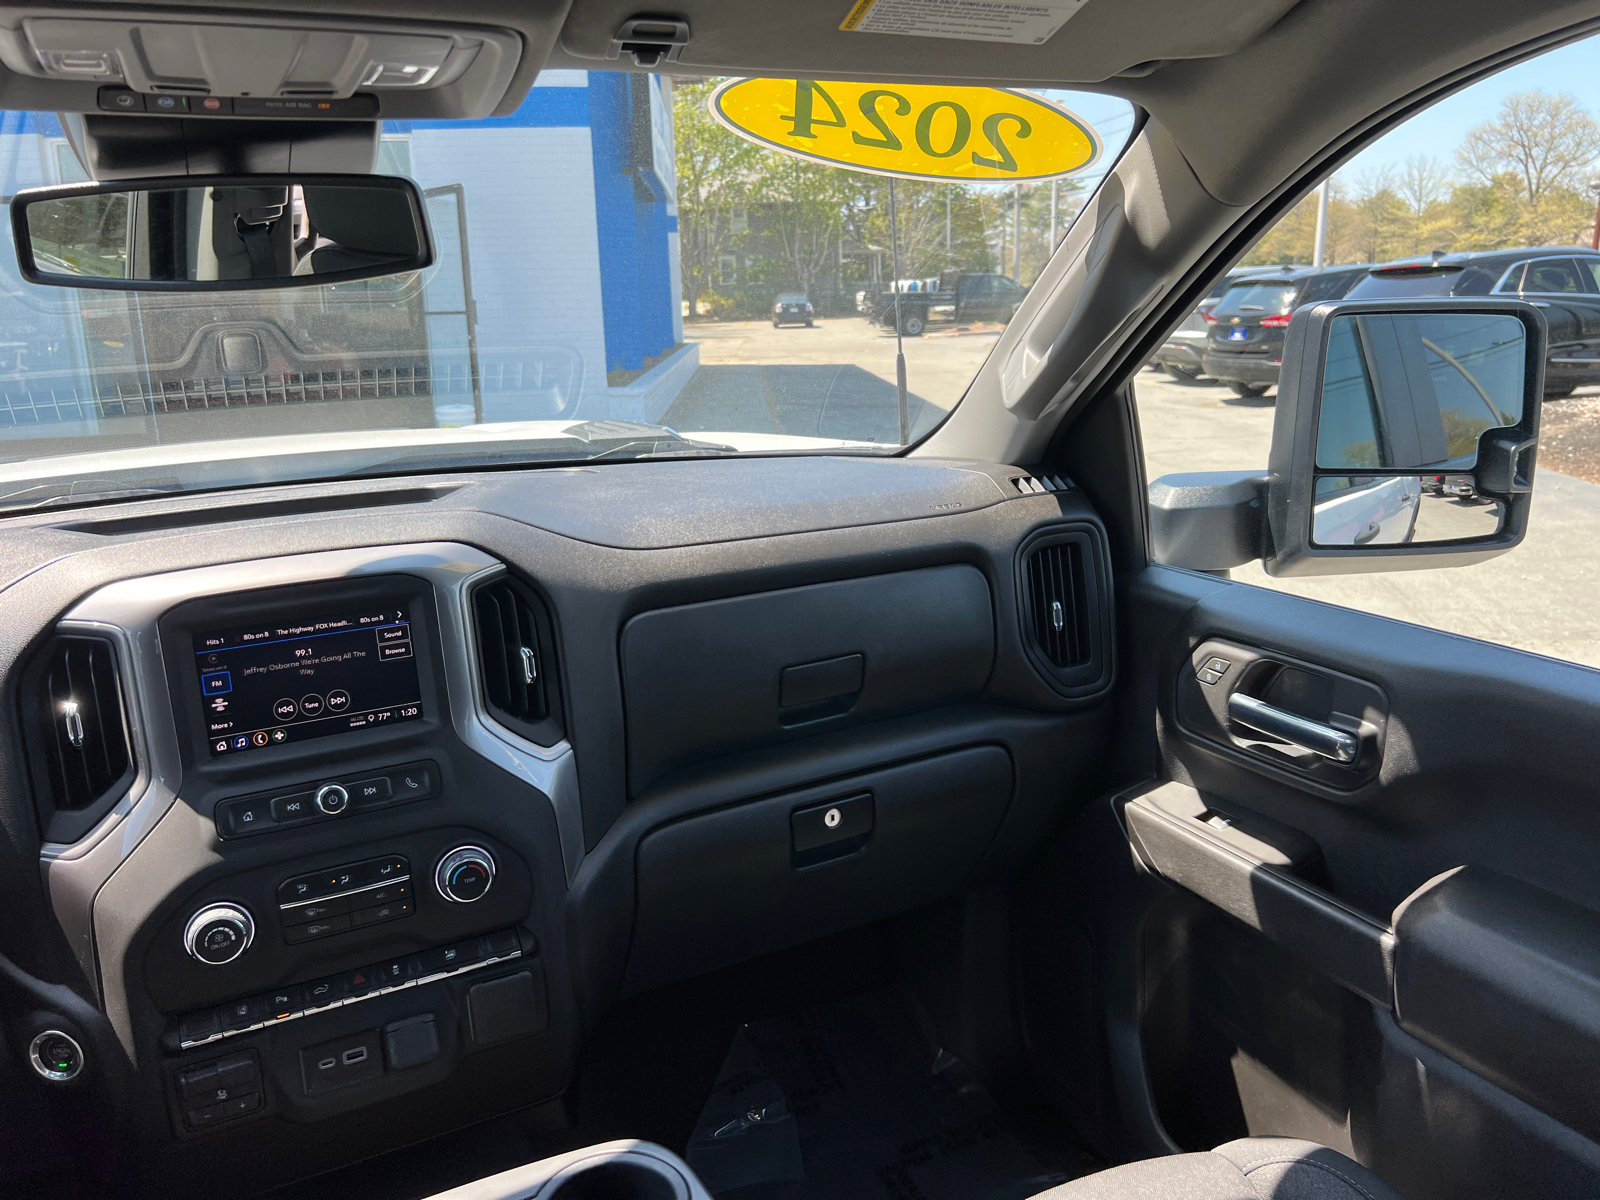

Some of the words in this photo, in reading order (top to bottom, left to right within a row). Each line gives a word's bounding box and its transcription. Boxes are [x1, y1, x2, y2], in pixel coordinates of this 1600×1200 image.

[276, 628, 289, 636] The
[289, 626, 314, 634] Highway
[384, 630, 402, 639] Sound
[295, 648, 312, 658] 99.1
[385, 647, 406, 655] Browse
[243, 665, 268, 676] Jeffrey
[269, 661, 300, 671] Osborne
[320, 654, 342, 663] Going
[299, 668, 315, 676] Way
[400, 707, 418, 717] 1:20
[211, 722, 229, 730] More
[464, 876, 476, 884] TEMP
[210, 940, 230, 950] ON/OFF
